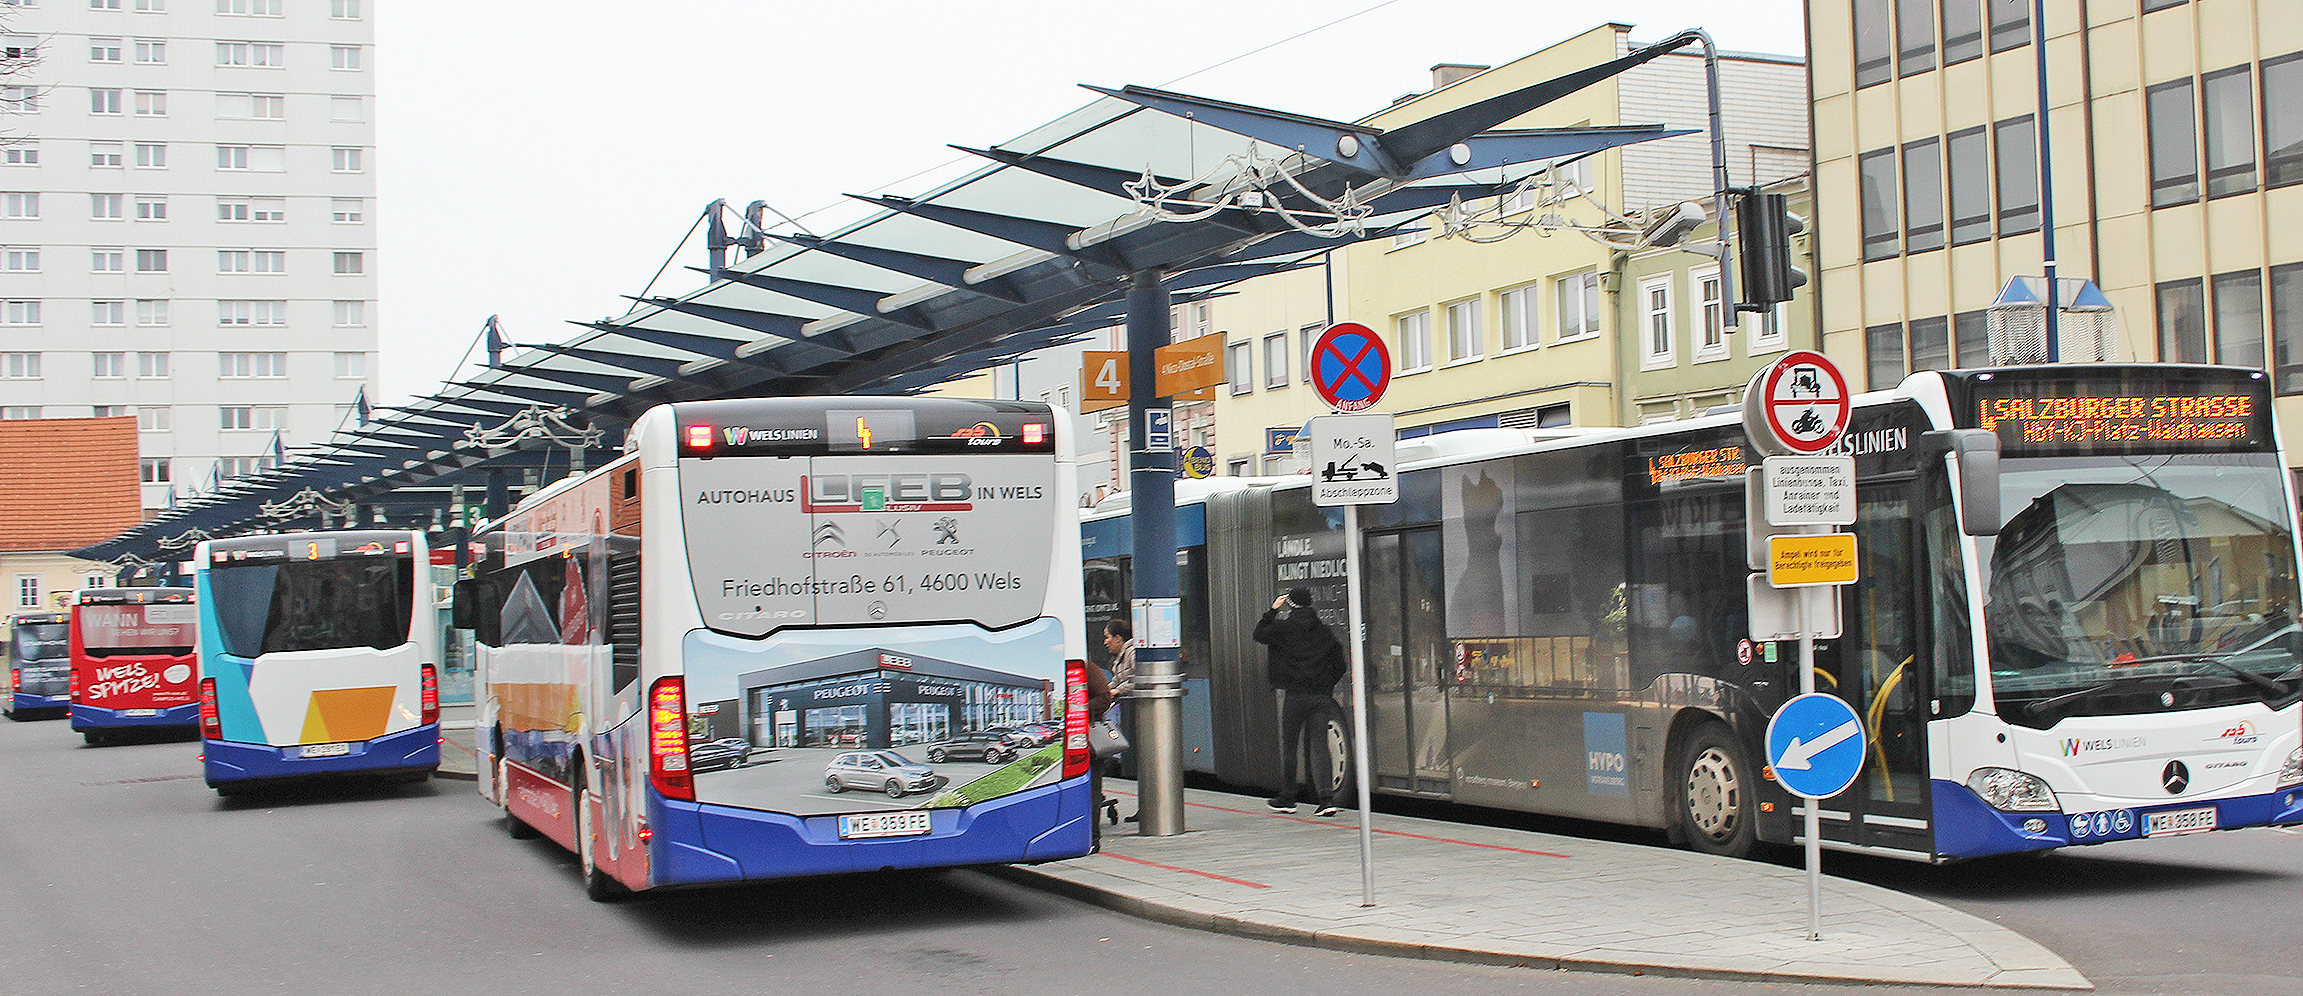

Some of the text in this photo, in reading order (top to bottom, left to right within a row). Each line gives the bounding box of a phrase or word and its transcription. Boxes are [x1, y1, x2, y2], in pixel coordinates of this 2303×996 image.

[1095, 358, 1121, 394] 4
[1335, 398, 1371, 411] ANFANG
[1979, 395, 2253, 432] 4 SALZBURGER STRASSE
[857, 416, 873, 449] 4
[967, 436, 1003, 446] tours
[1820, 426, 1908, 456] ELSLINIEN
[1333, 437, 1375, 449] Mo.-Sa.
[1780, 465, 1840, 477] ausgenommen
[697, 488, 795, 505] AUTOHAUS
[978, 487, 994, 499] IN
[999, 486, 1043, 500] WELS
[1320, 486, 1393, 498] Abschleppzone
[1783, 490, 1840, 501] Anrainer und
[469, 507, 481, 525] 3
[307, 542, 319, 561] 3
[802, 550, 857, 559] CITROËN
[921, 549, 974, 557] PEUGEOT
[722, 572, 1021, 597] Friedhofstraße 61, 4600 Wels
[55, 614, 63, 623] 2
[718, 609, 807, 622] CITARO
[95, 662, 148, 681] WELS
[88, 672, 161, 699] SPITZE!
[814, 683, 956, 699] PEUGEOT PEUGEOT
[2232, 735, 2257, 746] tours
[1588, 751, 1625, 772] HYPO
[2205, 761, 2248, 770] CITARO
[850, 817, 870, 832] WE
[910, 814, 925, 828] FE
[2150, 815, 2167, 831] WE
[2199, 811, 2214, 826] FE
